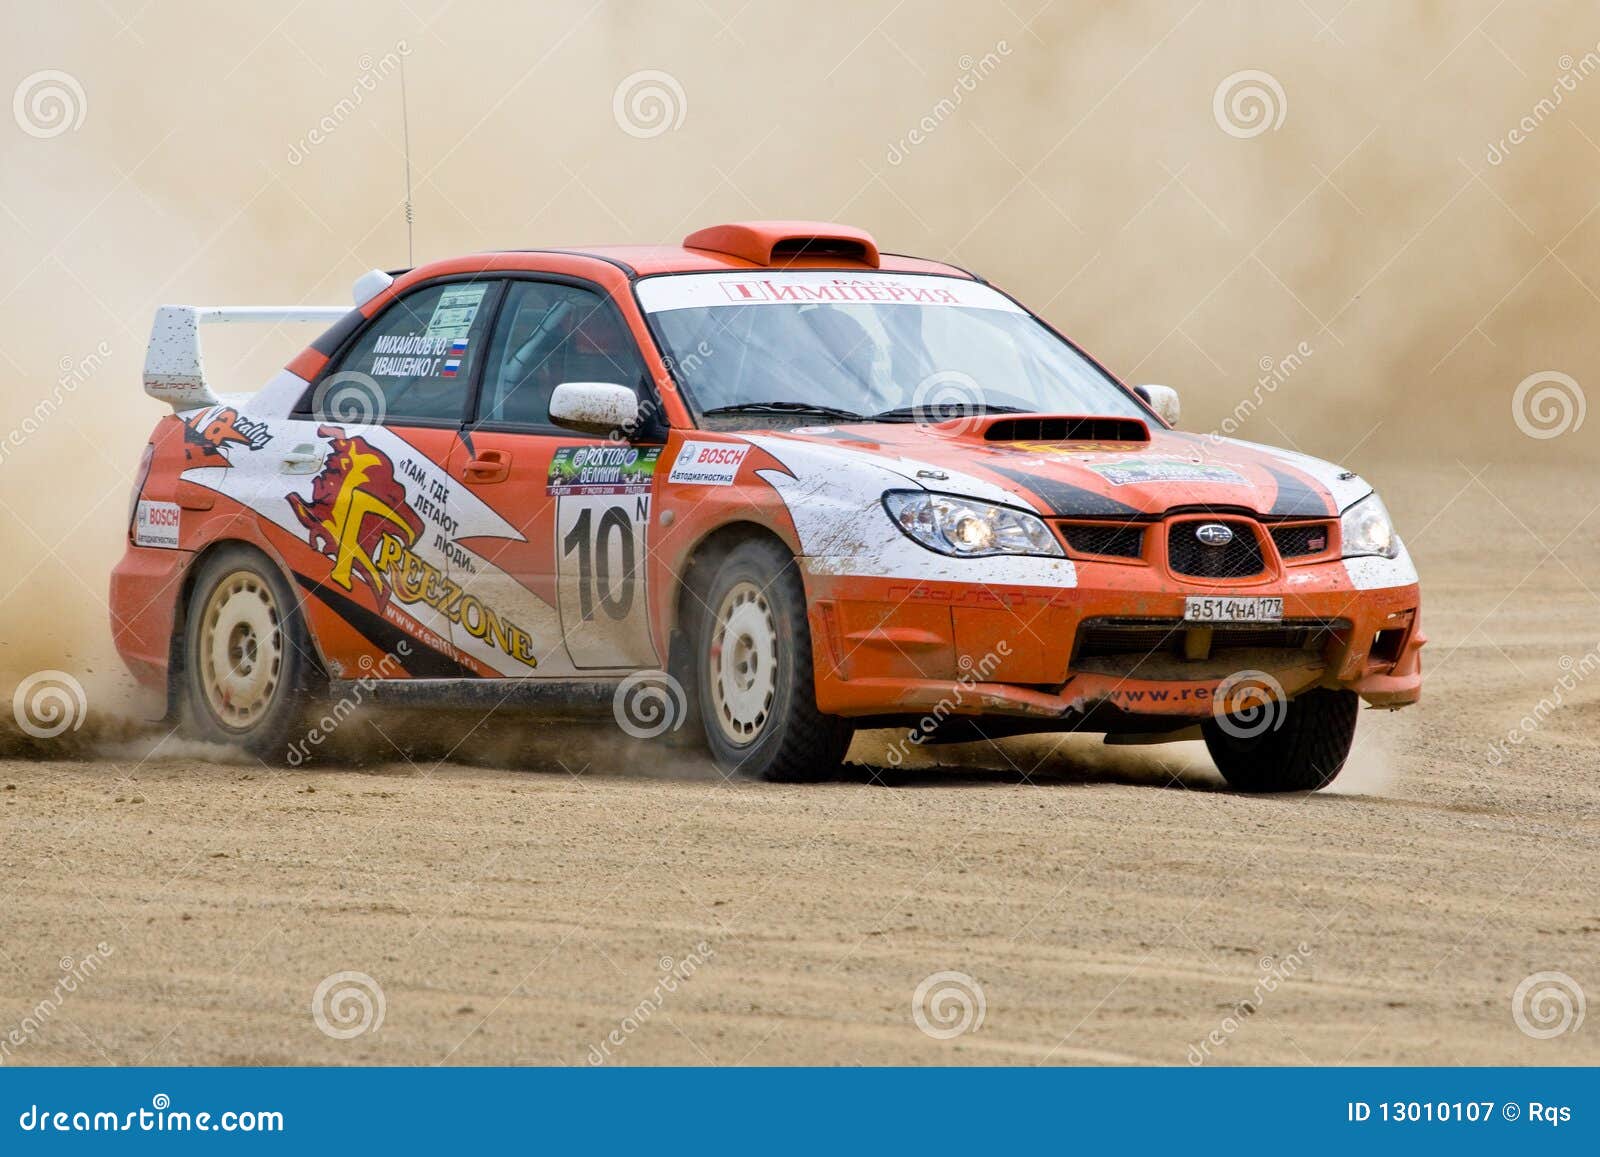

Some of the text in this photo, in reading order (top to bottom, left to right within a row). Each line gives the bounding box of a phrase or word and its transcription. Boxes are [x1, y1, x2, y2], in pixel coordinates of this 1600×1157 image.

[373, 332, 432, 354] МИХАЙЛОВ
[371, 357, 430, 377] ИВАЩЕНКО
[585, 448, 628, 466] РОСТОВ
[698, 448, 745, 464] BOSCH
[429, 478, 450, 505] ГДЕ
[150, 508, 178, 526] BOSCH
[414, 494, 459, 537] ЛЕТАЮТ
[636, 497, 648, 521] N
[564, 506, 635, 621] 10
